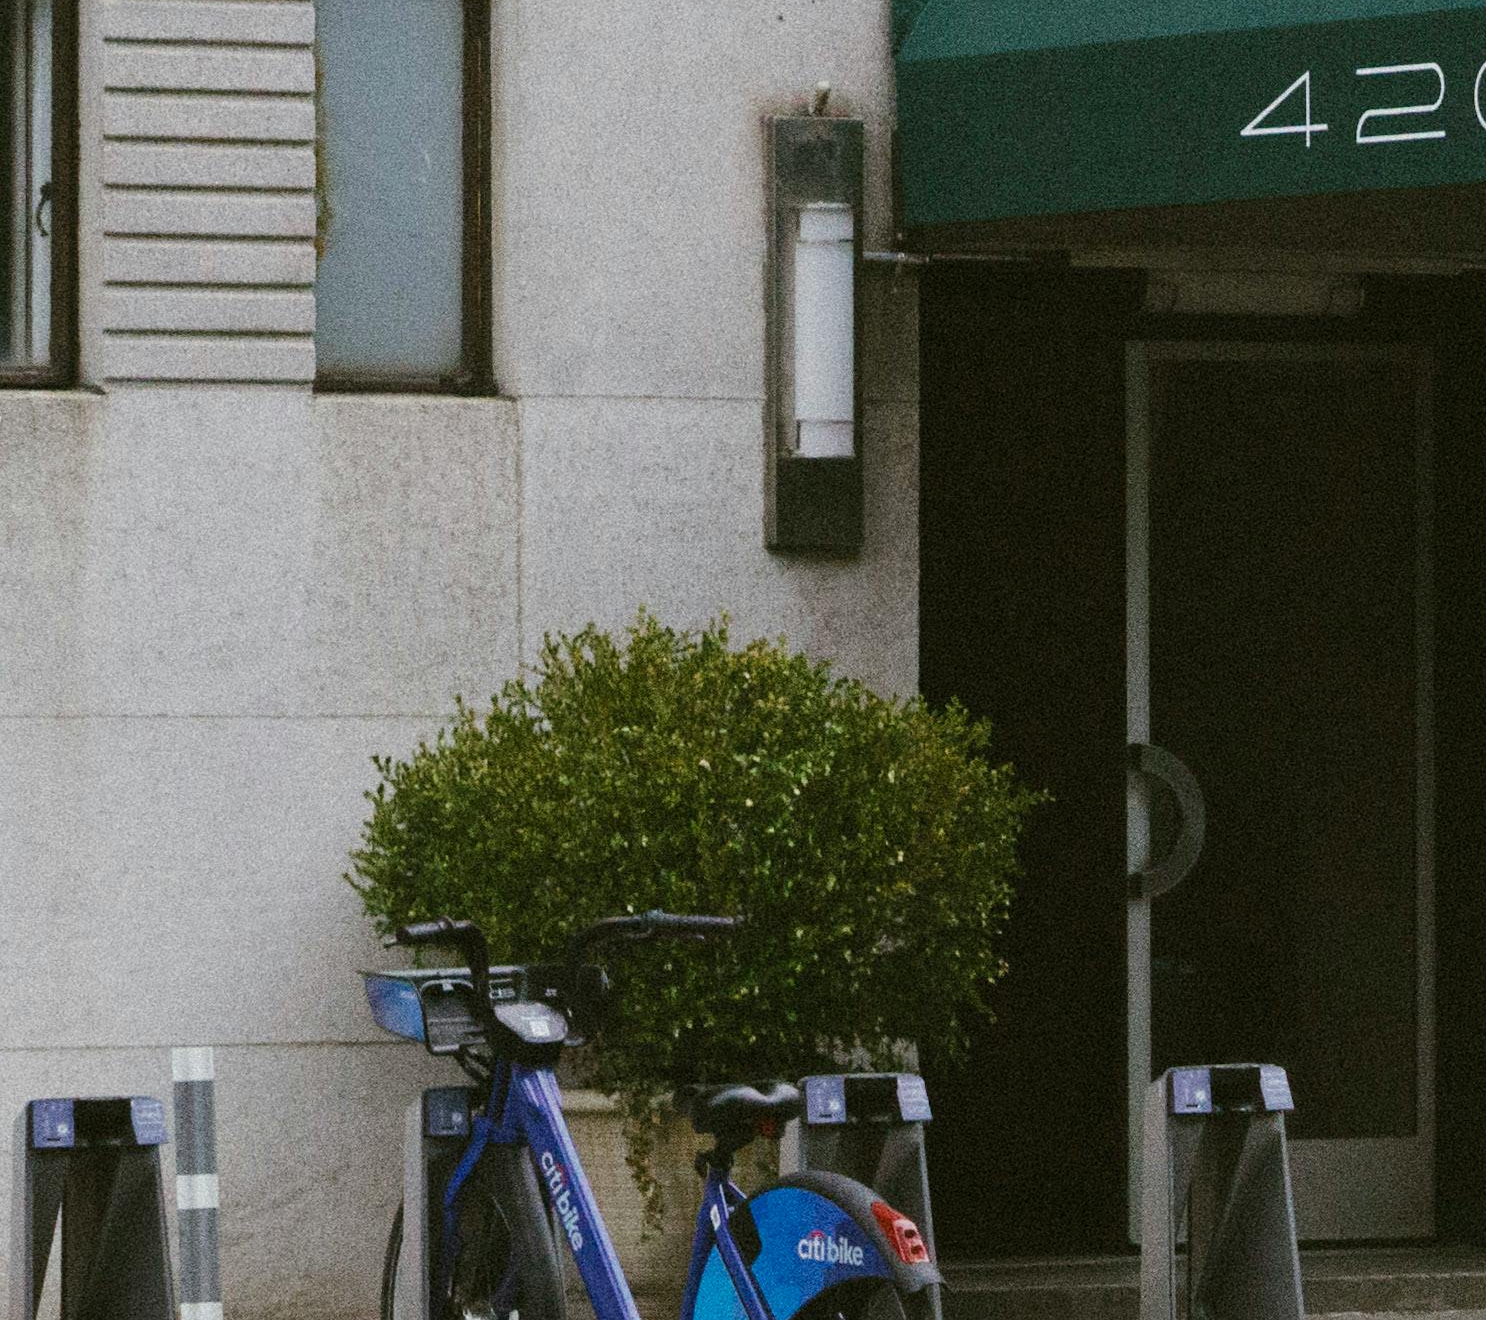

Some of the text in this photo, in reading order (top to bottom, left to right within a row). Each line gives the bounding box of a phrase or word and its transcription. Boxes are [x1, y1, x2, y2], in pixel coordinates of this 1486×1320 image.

[541, 1151, 584, 1251] citi bike
[797, 1235, 864, 1267] citi bike
